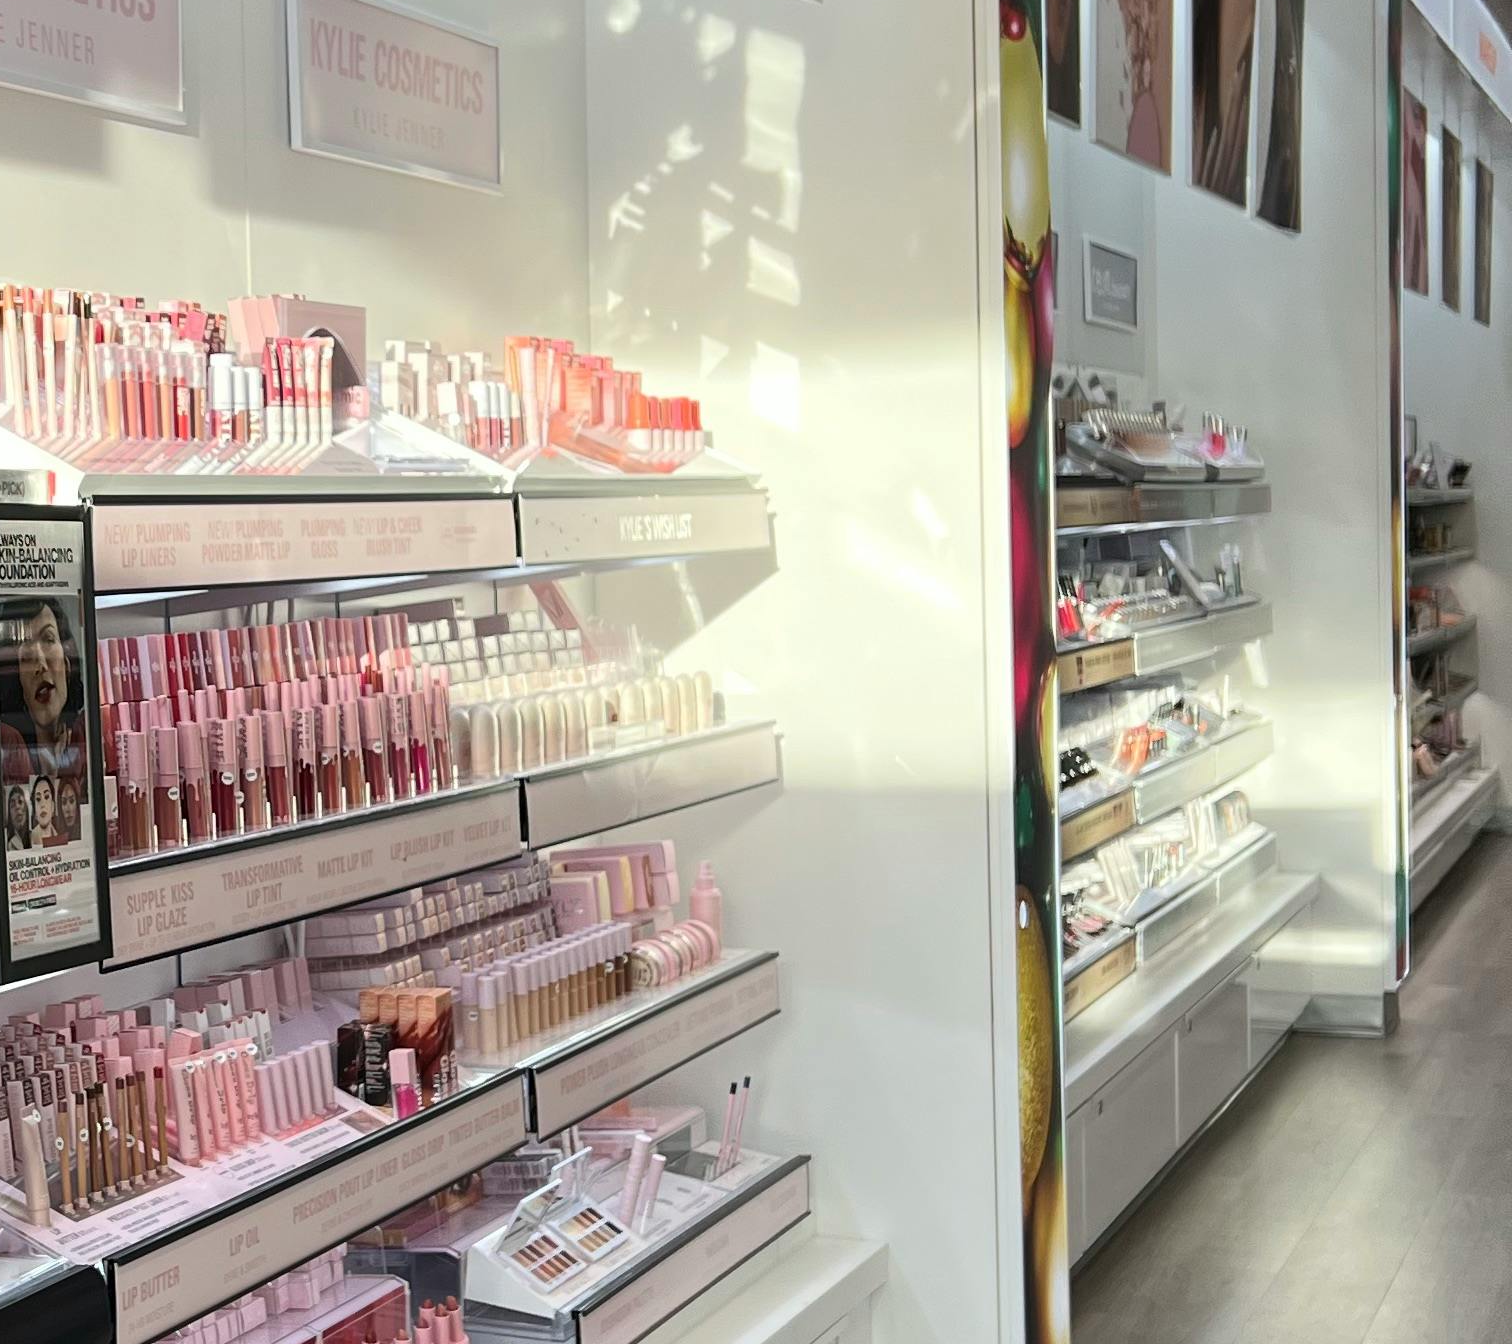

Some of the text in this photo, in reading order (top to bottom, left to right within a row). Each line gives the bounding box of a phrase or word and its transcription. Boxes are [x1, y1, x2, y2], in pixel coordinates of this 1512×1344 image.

[15, 19, 96, 67] JENNER
[309, 17, 484, 116] KYLIE COSMETICS
[24, 534, 36, 546] ON
[136, 522, 191, 543] PLUMPING
[221, 855, 304, 892] TRANSFORMATIVE
[317, 856, 346, 881] MATTE
[126, 880, 194, 917] SUPPLE KISS
[246, 887, 262, 909] LIP
[262, 882, 283, 905] TINT
[136, 915, 154, 937] LIP
[155, 908, 188, 933] GLAZE
[292, 1190, 337, 1225] PRECISION
[228, 1226, 260, 1258] LIP OIL
[121, 1264, 180, 1312] LIP BUTTER
